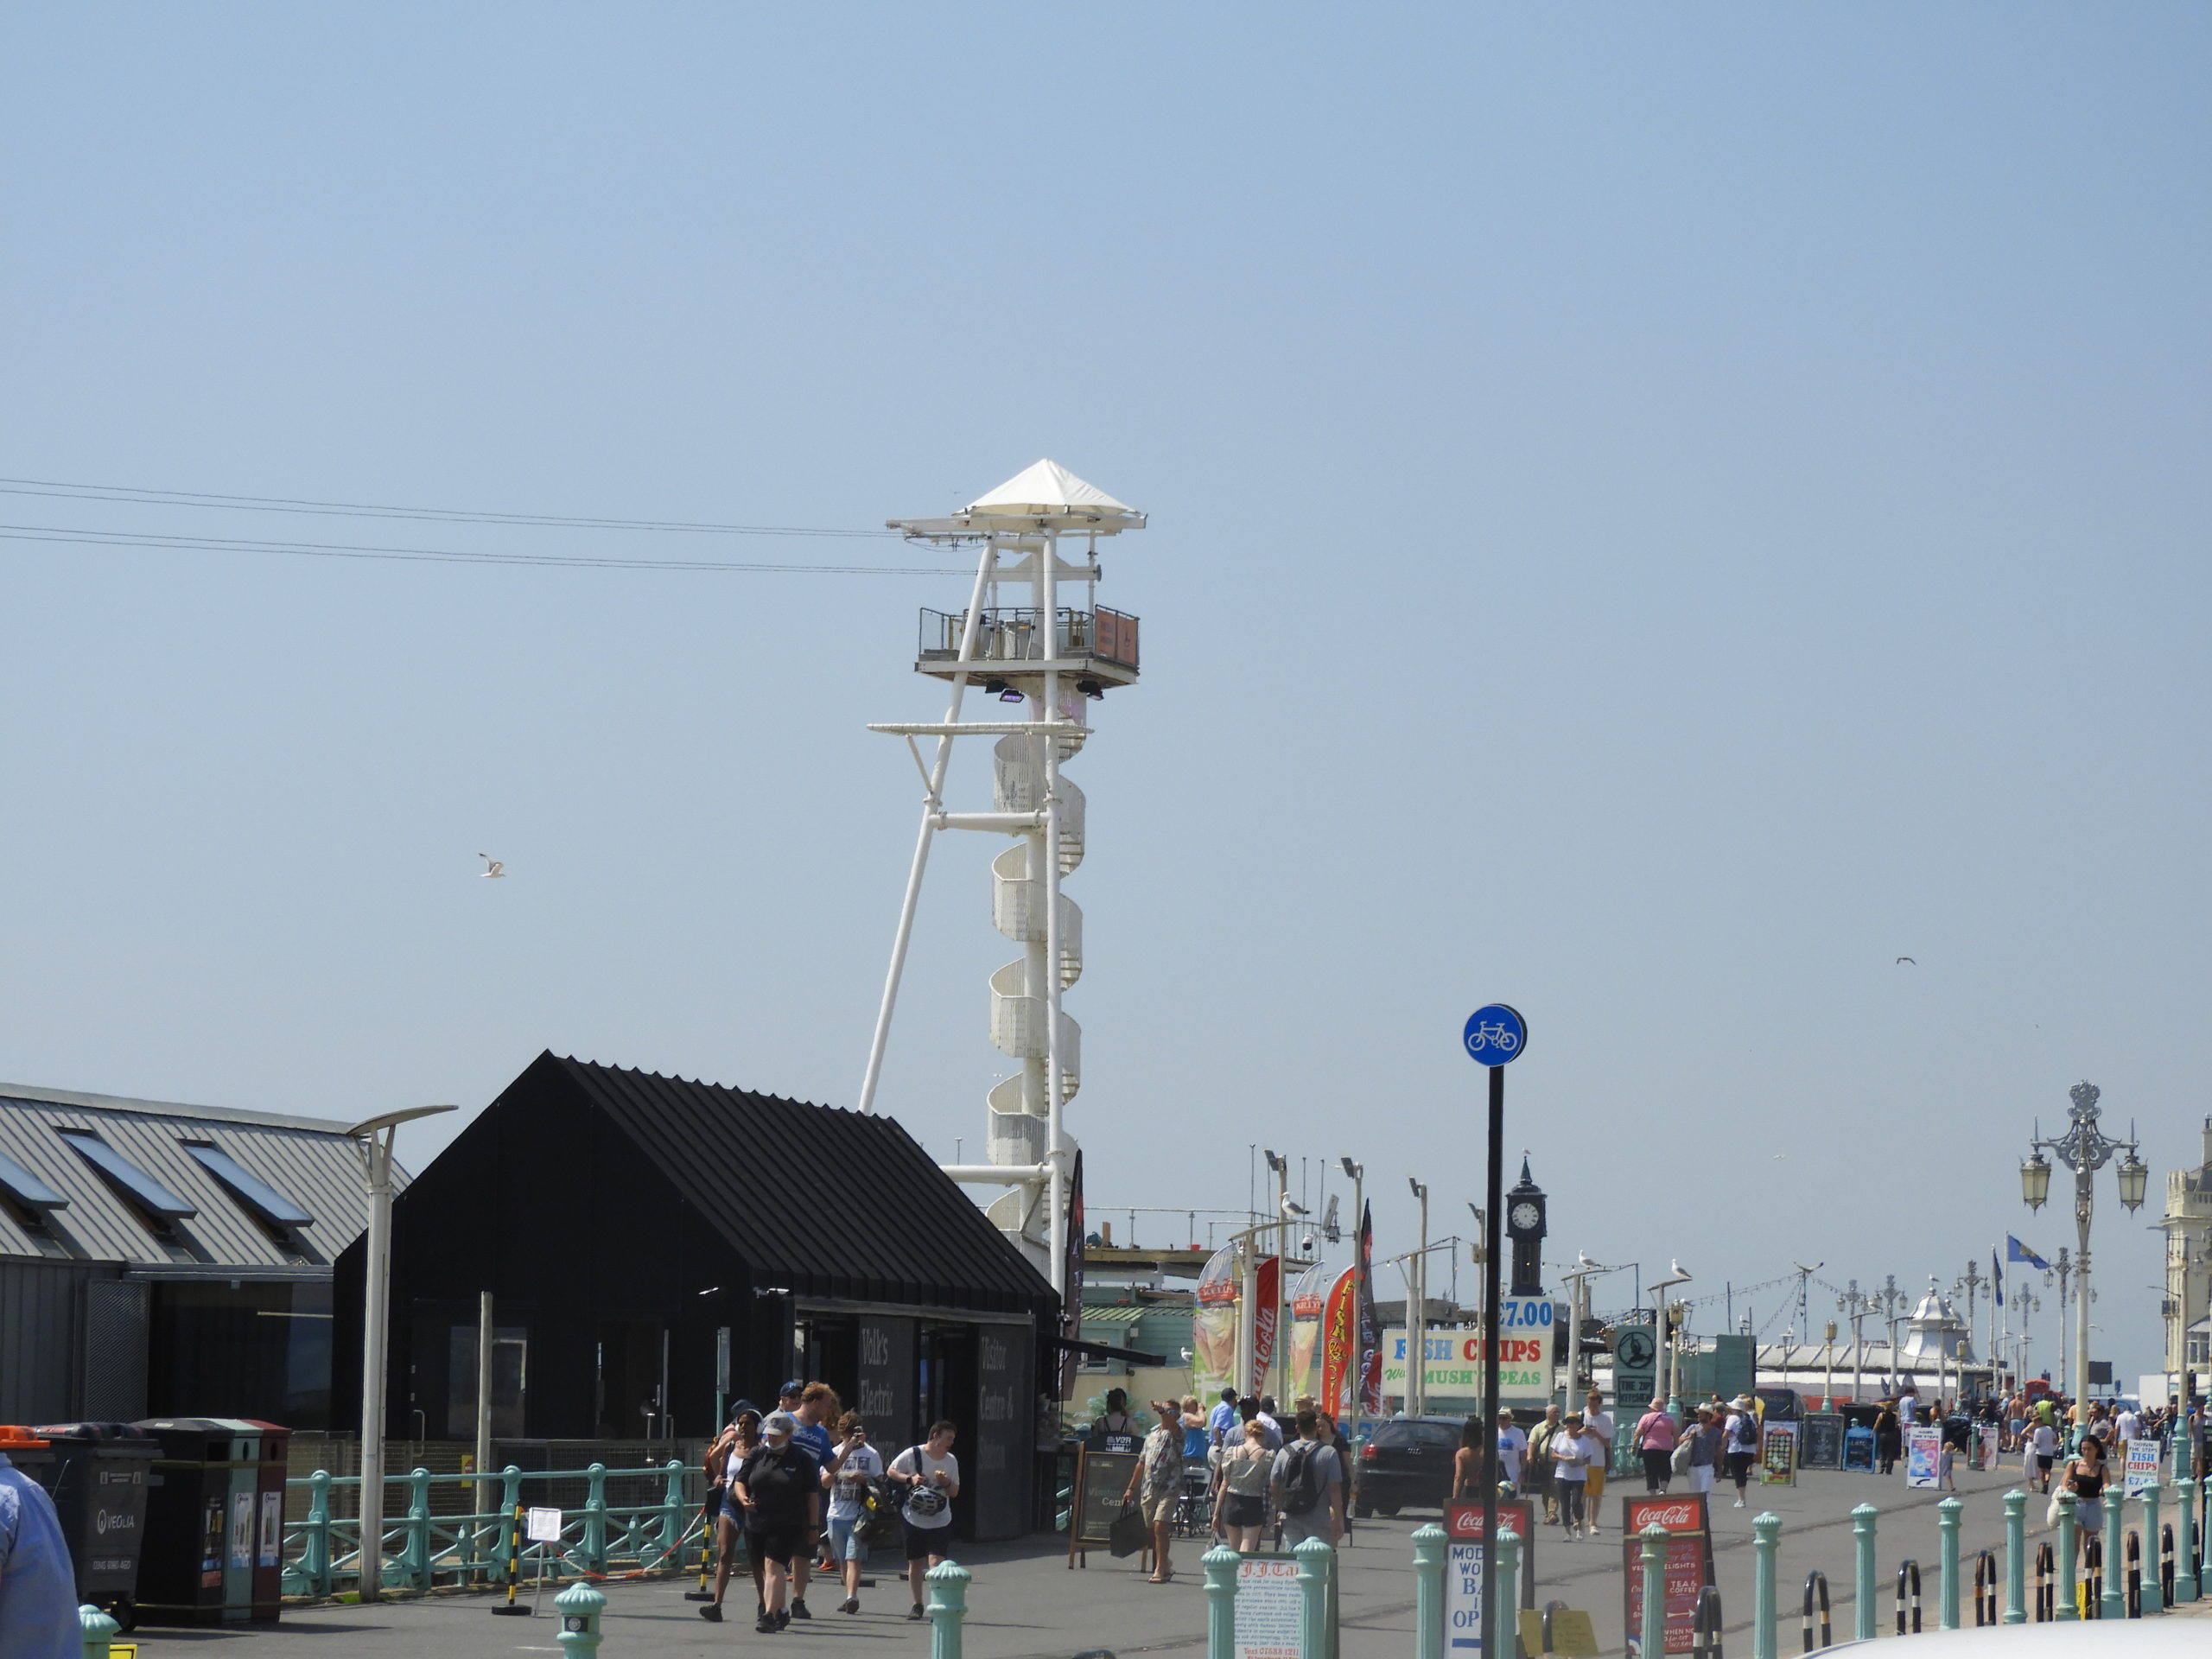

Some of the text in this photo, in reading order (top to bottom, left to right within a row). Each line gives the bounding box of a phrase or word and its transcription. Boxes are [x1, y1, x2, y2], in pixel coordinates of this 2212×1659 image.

[862, 1328, 888, 1365] Volk's
[982, 1336, 1007, 1370] Visitor
[1394, 1338, 1541, 1362] FSH CIPS
[1385, 1369, 1406, 1381] Wi
[1499, 1370, 1541, 1385] PEAS
[861, 1379, 893, 1416] Electric
[980, 1385, 1005, 1421] Centre
[2128, 1462, 2158, 1471] CHIPS
[2132, 1452, 2154, 1461] FISH
[107, 1515, 135, 1529] VEOLIA
[1452, 1547, 1484, 1560] MOD
